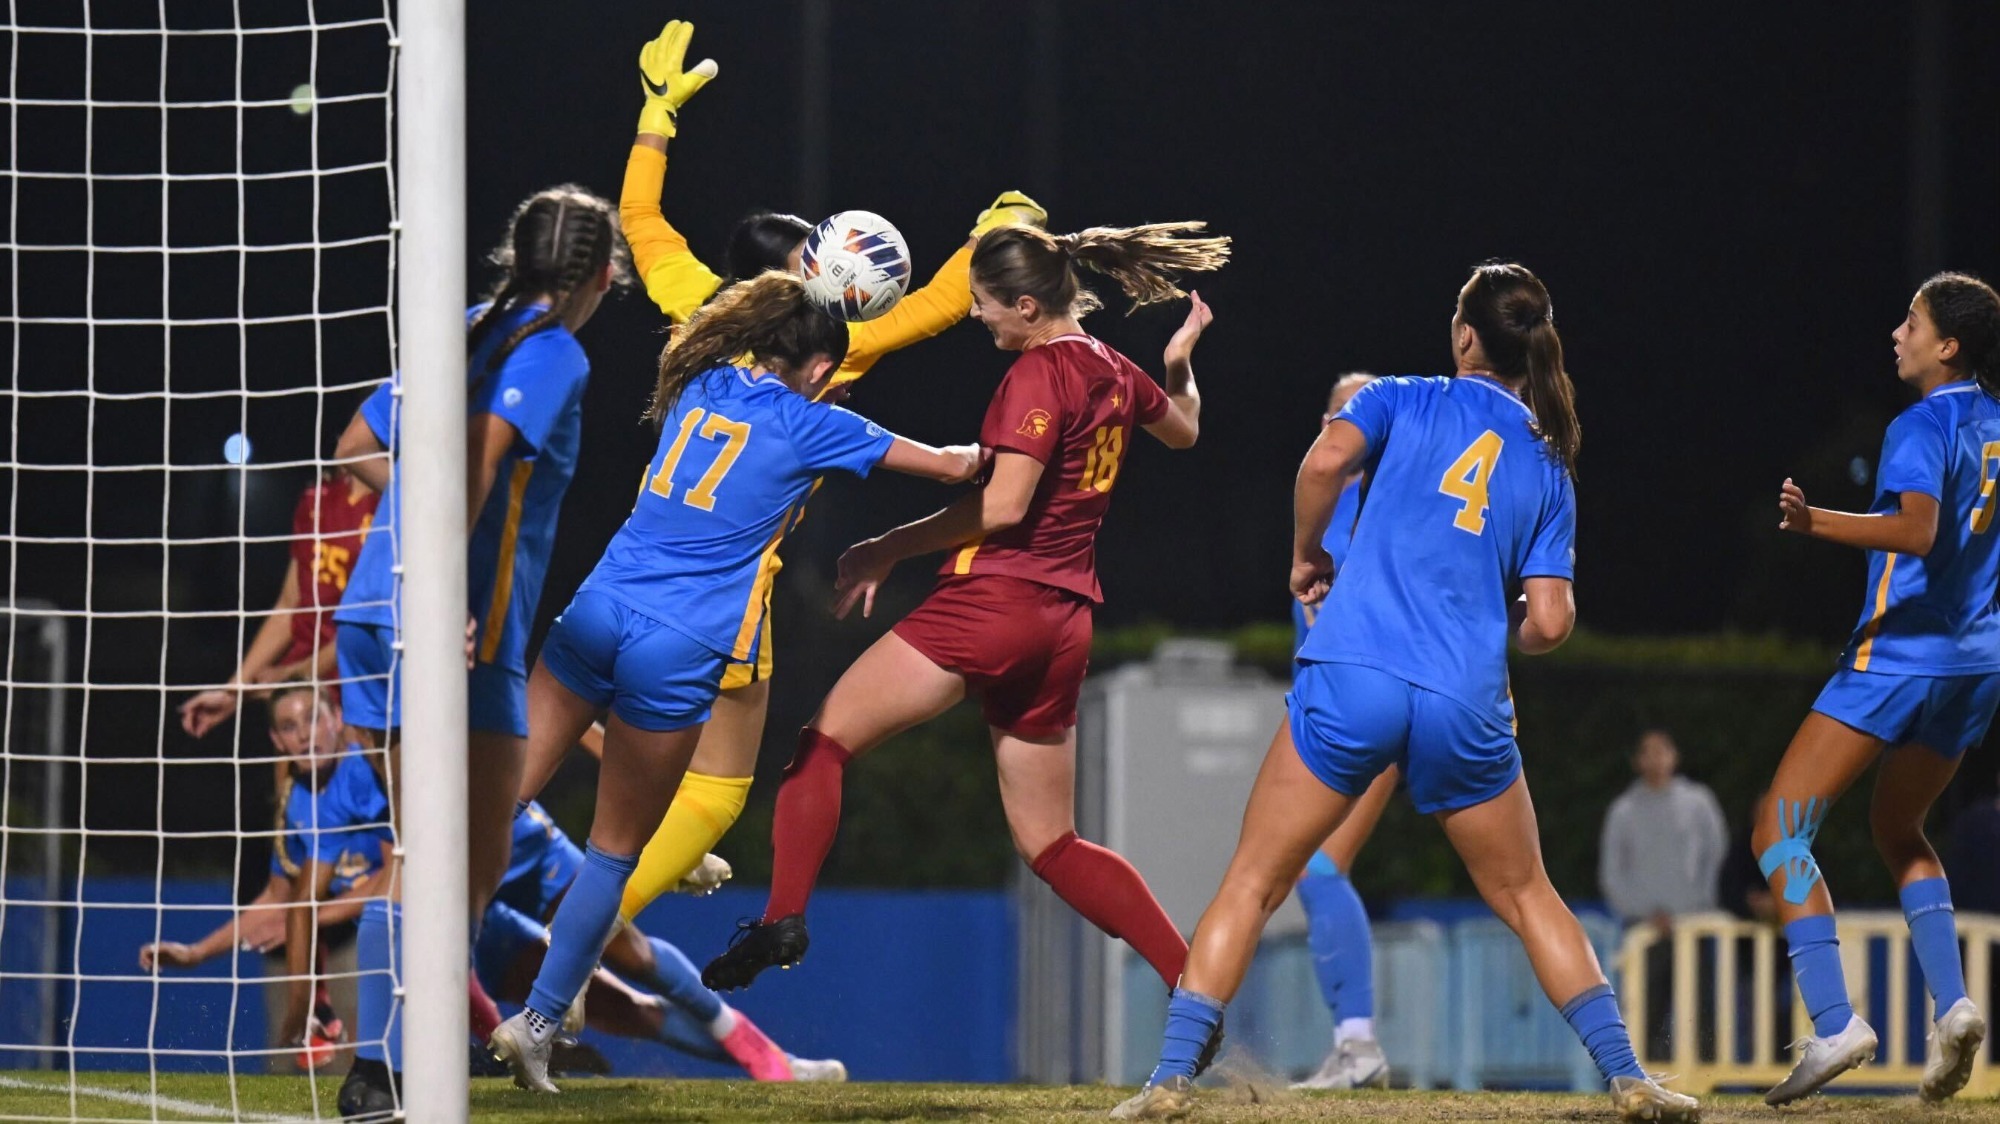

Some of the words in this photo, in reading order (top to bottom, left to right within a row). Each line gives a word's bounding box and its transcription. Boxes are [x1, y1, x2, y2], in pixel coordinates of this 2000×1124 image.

[649, 406, 752, 513] 17
[1076, 425, 1123, 493] 18
[1438, 429, 1504, 536] 4
[311, 542, 349, 591] 25
